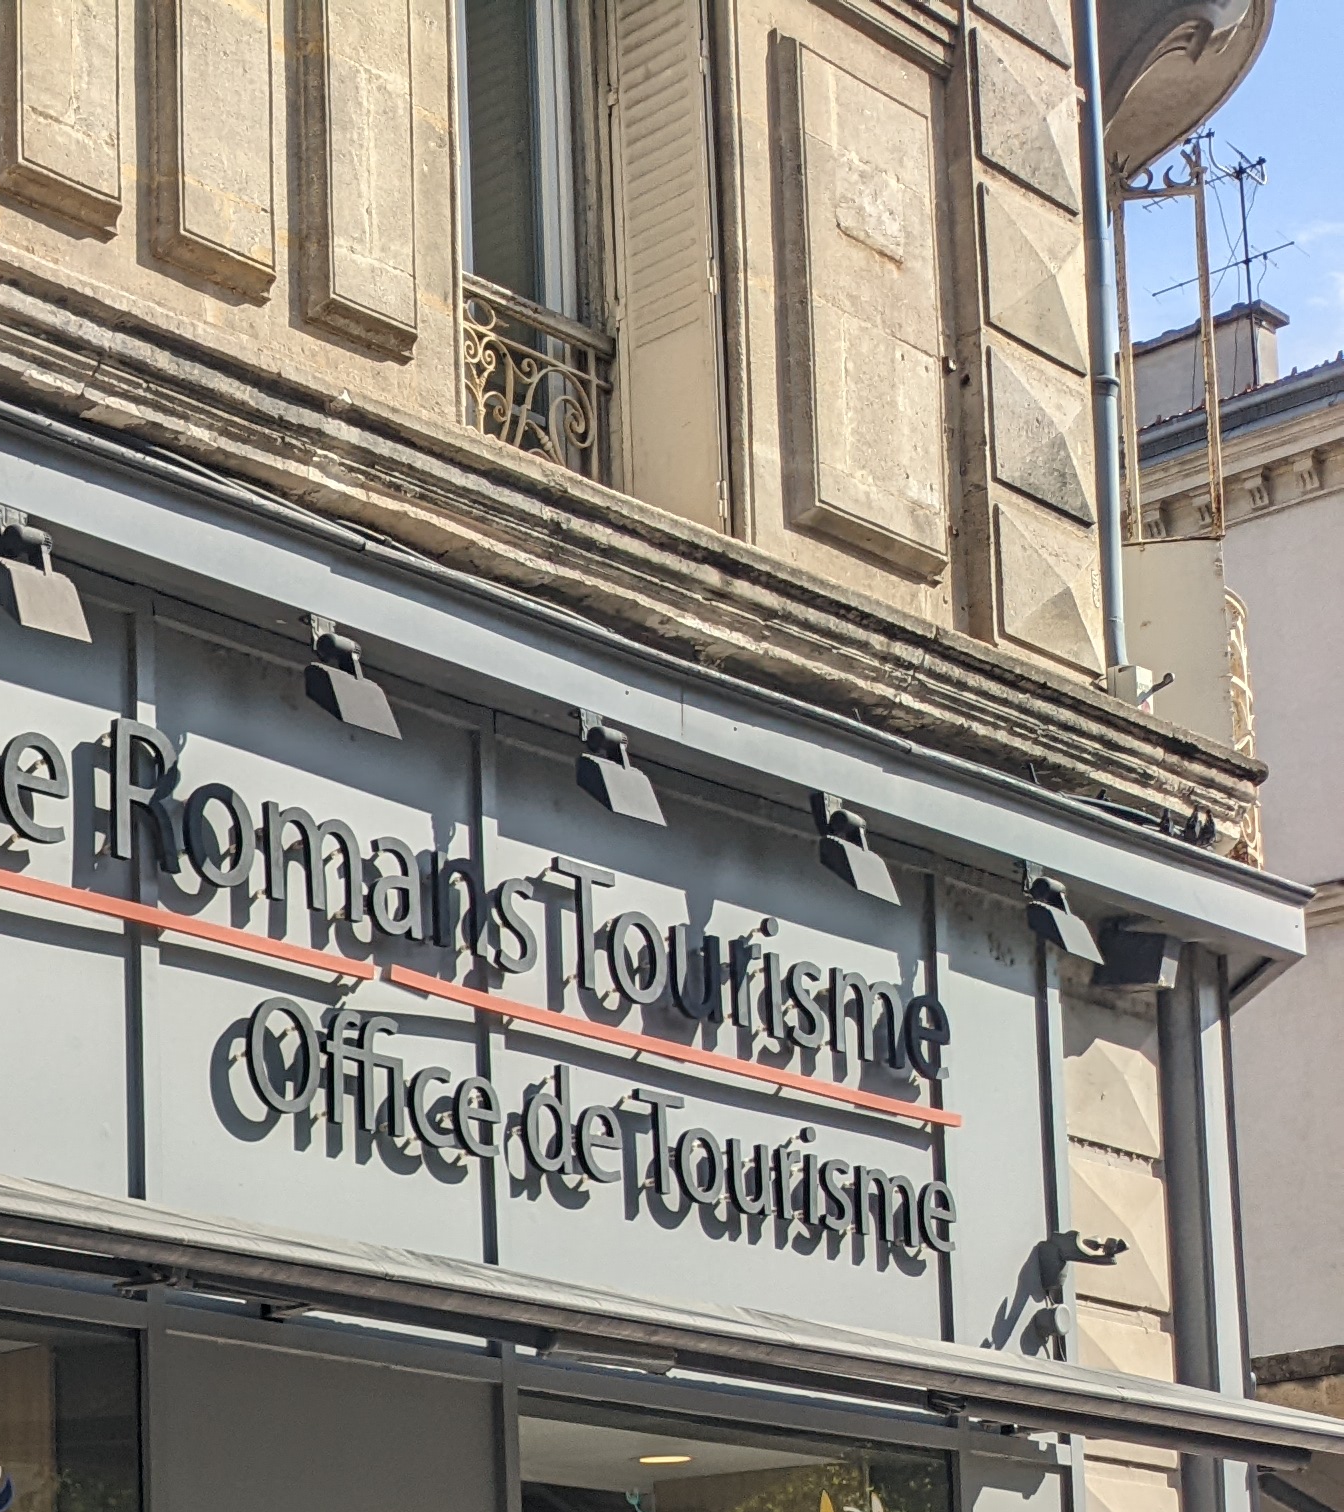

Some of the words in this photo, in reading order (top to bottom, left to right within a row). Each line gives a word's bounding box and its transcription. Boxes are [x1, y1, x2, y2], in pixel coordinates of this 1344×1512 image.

[109, 717, 538, 975] Romans
[551, 857, 952, 1082] Tourisme
[245, 995, 502, 1160] Office
[519, 1063, 623, 1185] de
[633, 1086, 959, 1253] Tourisme
